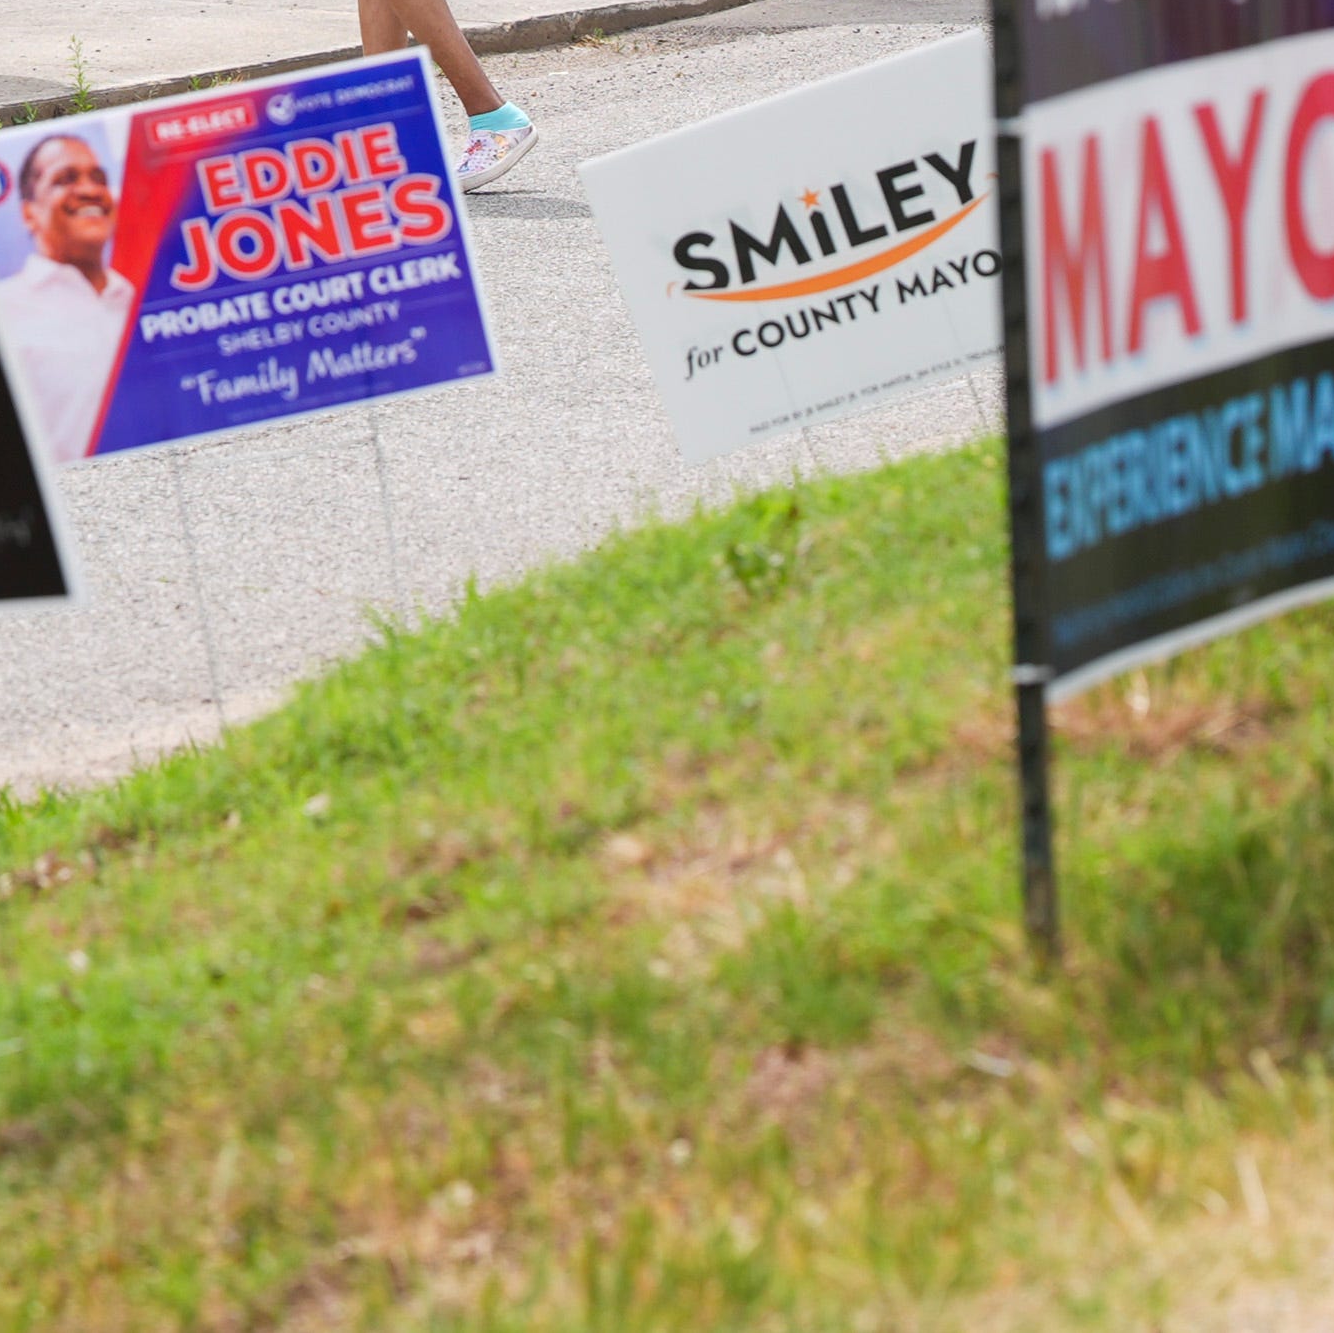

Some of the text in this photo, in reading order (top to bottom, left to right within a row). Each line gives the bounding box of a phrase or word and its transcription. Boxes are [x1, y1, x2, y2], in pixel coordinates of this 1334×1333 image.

[155, 107, 246, 141] RE-ELECT
[335, 75, 414, 104] DEMOCRAT
[197, 123, 406, 215] EDDIE
[170, 174, 454, 291] JONES
[140, 253, 462, 342] PROBATE COURT CLERK
[218, 299, 400, 356] SHELBY COUNTY
[685, 249, 1002, 380] for COUNTY MAYO
[1042, 391, 1267, 561] EXPERIENCE
